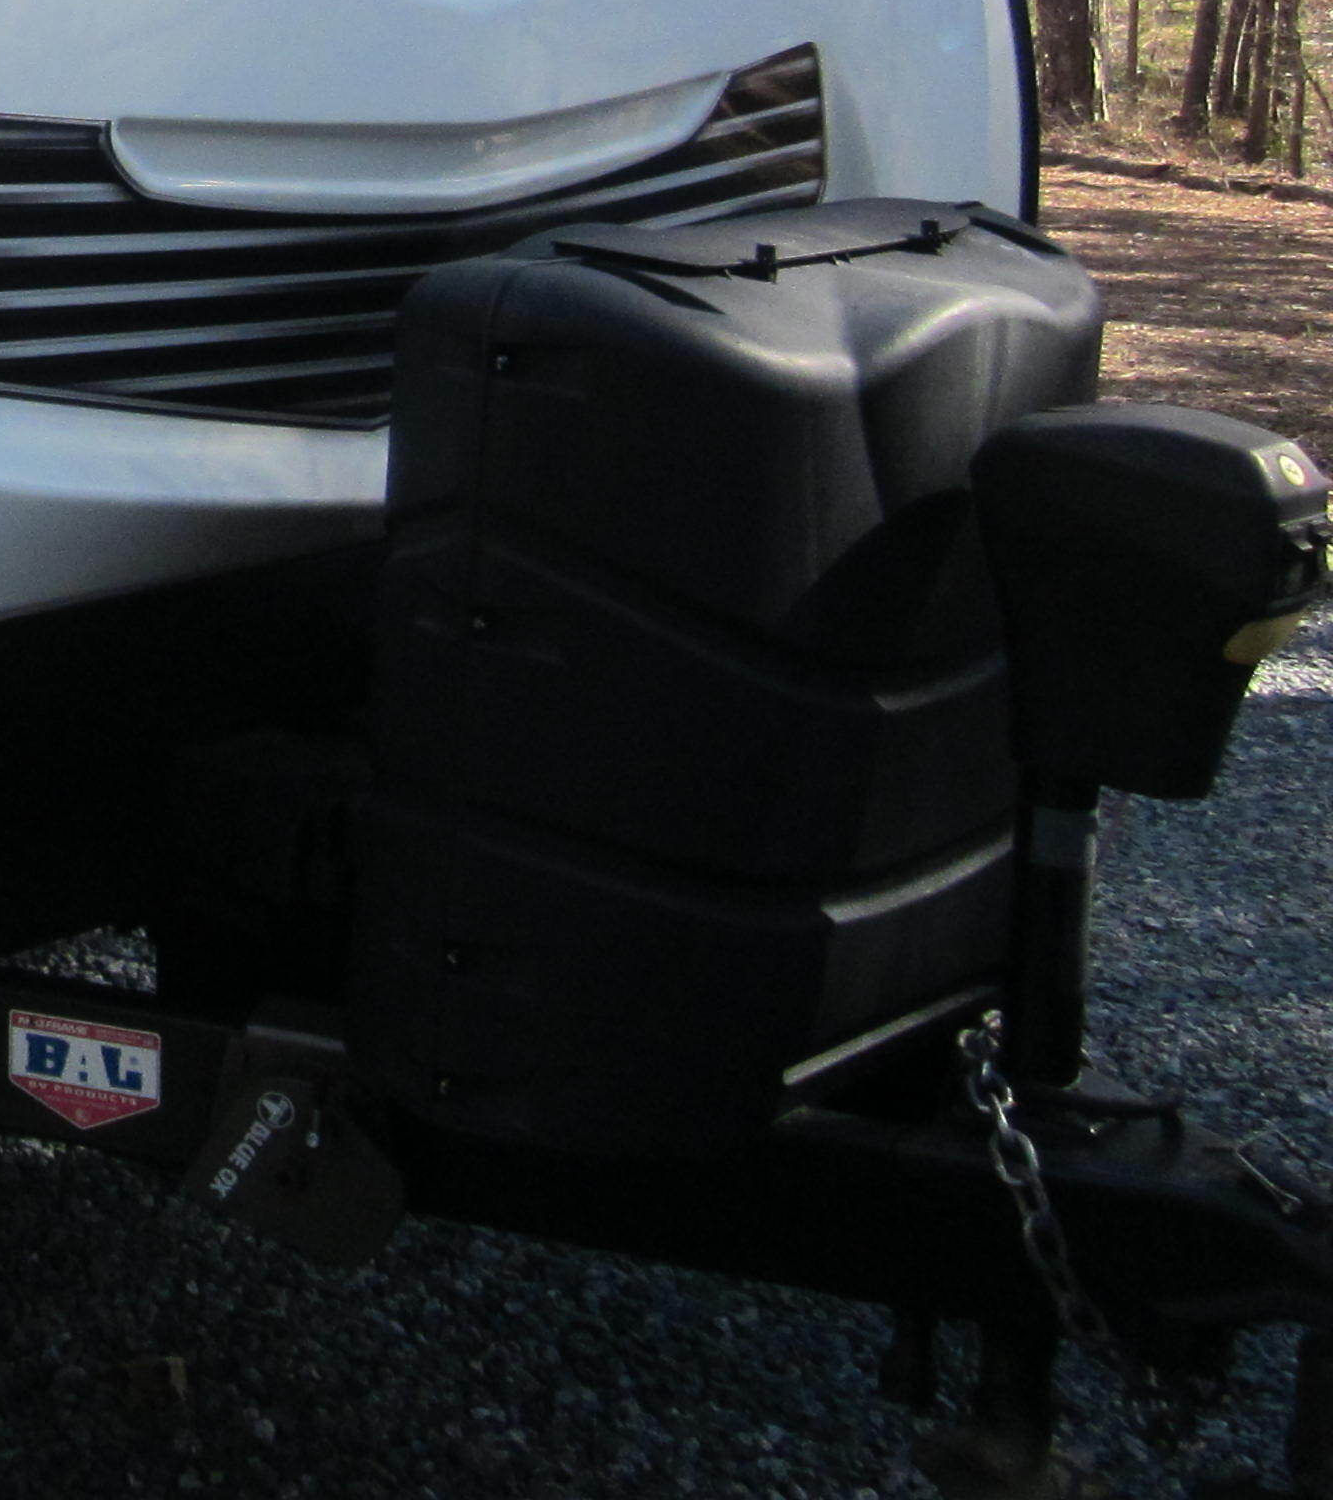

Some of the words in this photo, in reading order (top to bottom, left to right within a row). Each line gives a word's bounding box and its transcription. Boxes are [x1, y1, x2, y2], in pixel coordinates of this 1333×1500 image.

[25, 1032, 143, 1093] BAL
[53, 1083, 138, 1107] PRODUCTS
[227, 1120, 272, 1171] BLUE
[208, 1167, 238, 1200] OX
